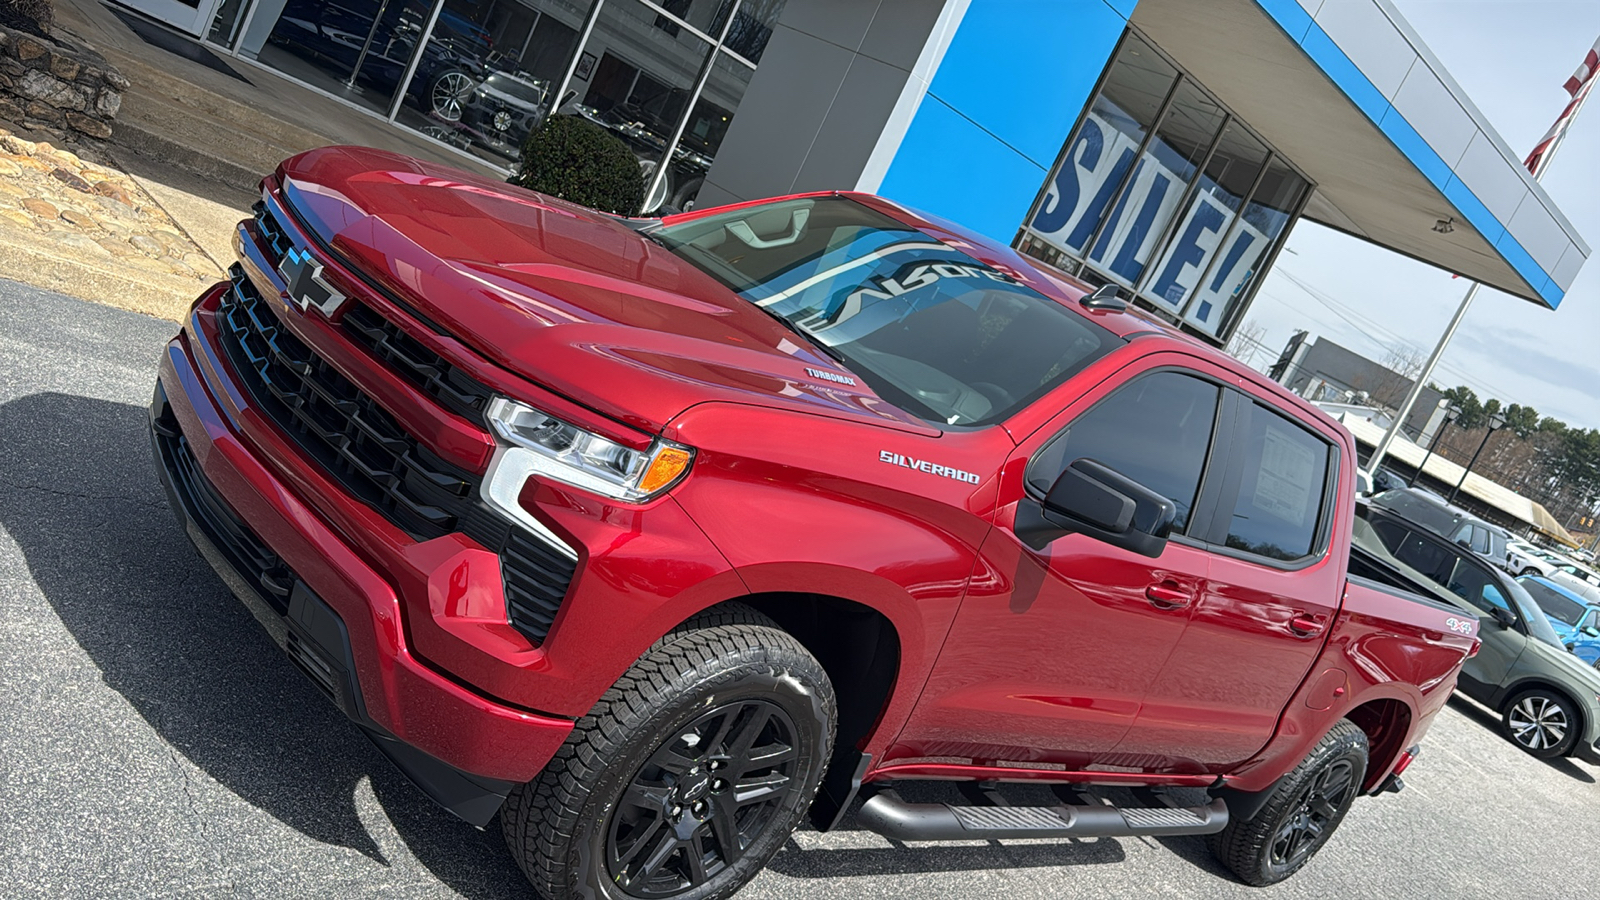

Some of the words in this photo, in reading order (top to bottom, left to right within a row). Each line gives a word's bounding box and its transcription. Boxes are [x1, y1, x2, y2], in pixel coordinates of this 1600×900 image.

[1031, 116, 1256, 323] SALE!
[804, 367, 857, 387] TURBOMAX
[879, 449, 981, 485] SILVERADO
